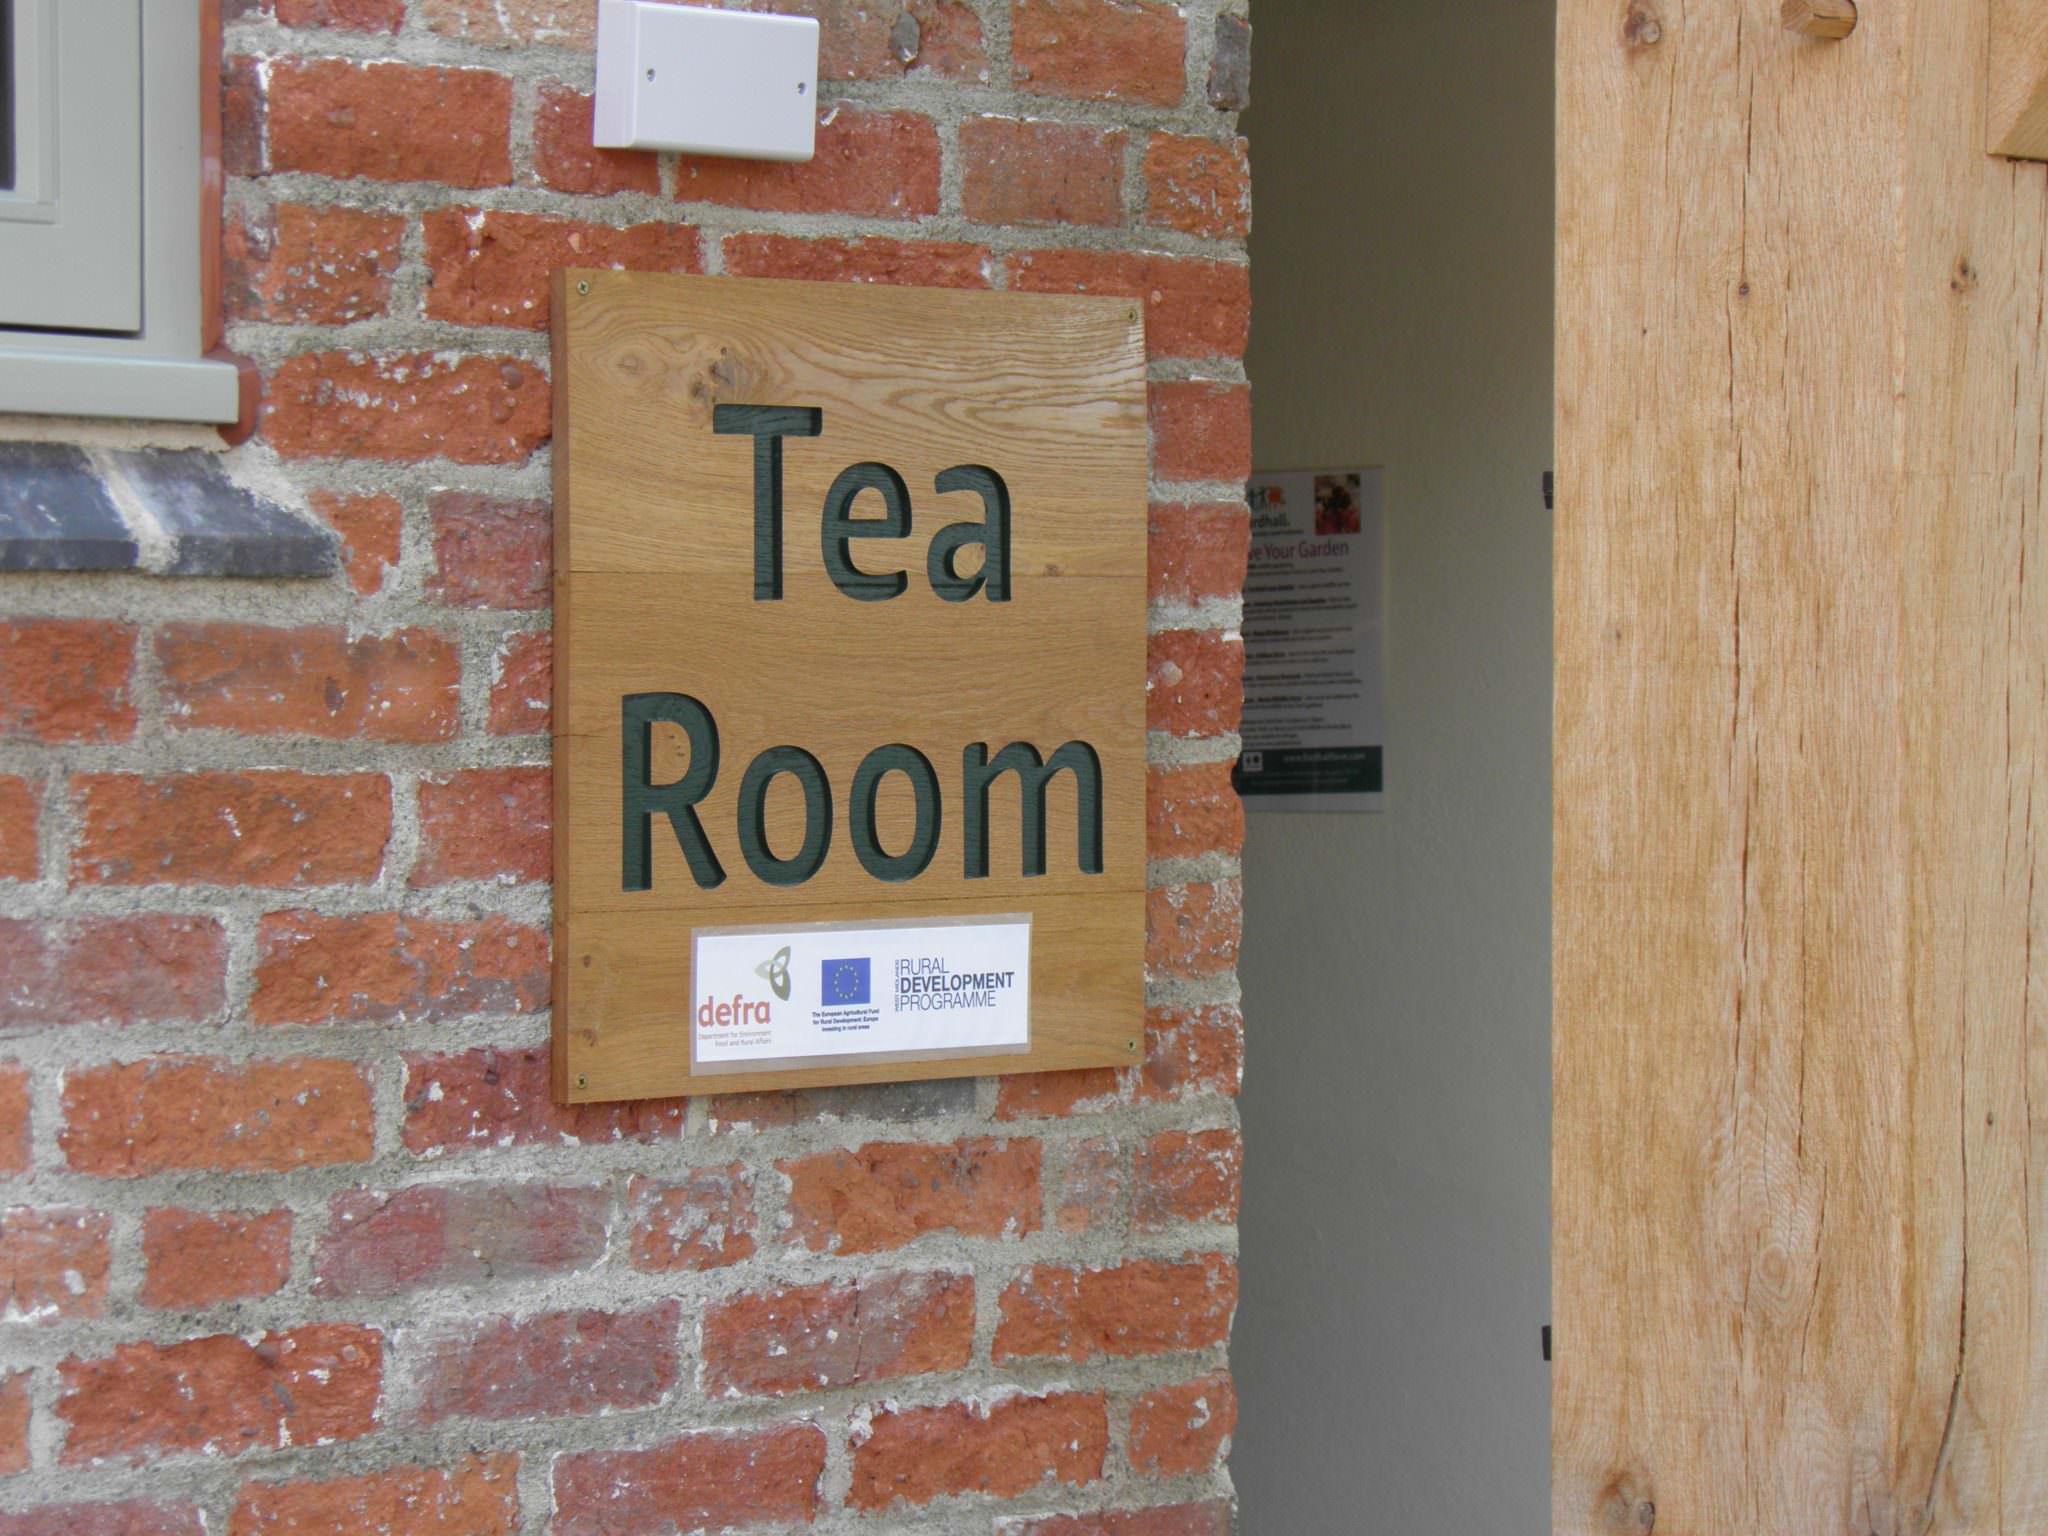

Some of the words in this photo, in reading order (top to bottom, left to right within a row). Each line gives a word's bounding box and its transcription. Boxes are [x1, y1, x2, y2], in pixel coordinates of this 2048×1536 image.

[712, 403, 1013, 603] Tea
[1264, 543, 1296, 559] Your
[1298, 538, 1349, 558] Garden
[621, 692, 1104, 891] Room
[900, 957, 950, 976] RURAL
[900, 971, 1015, 993] DEVELOPMENT
[698, 994, 771, 1027] defra
[900, 990, 997, 1011] PROGRAMME
[821, 1010, 842, 1018] European
[843, 1009, 867, 1017] Agricultural
